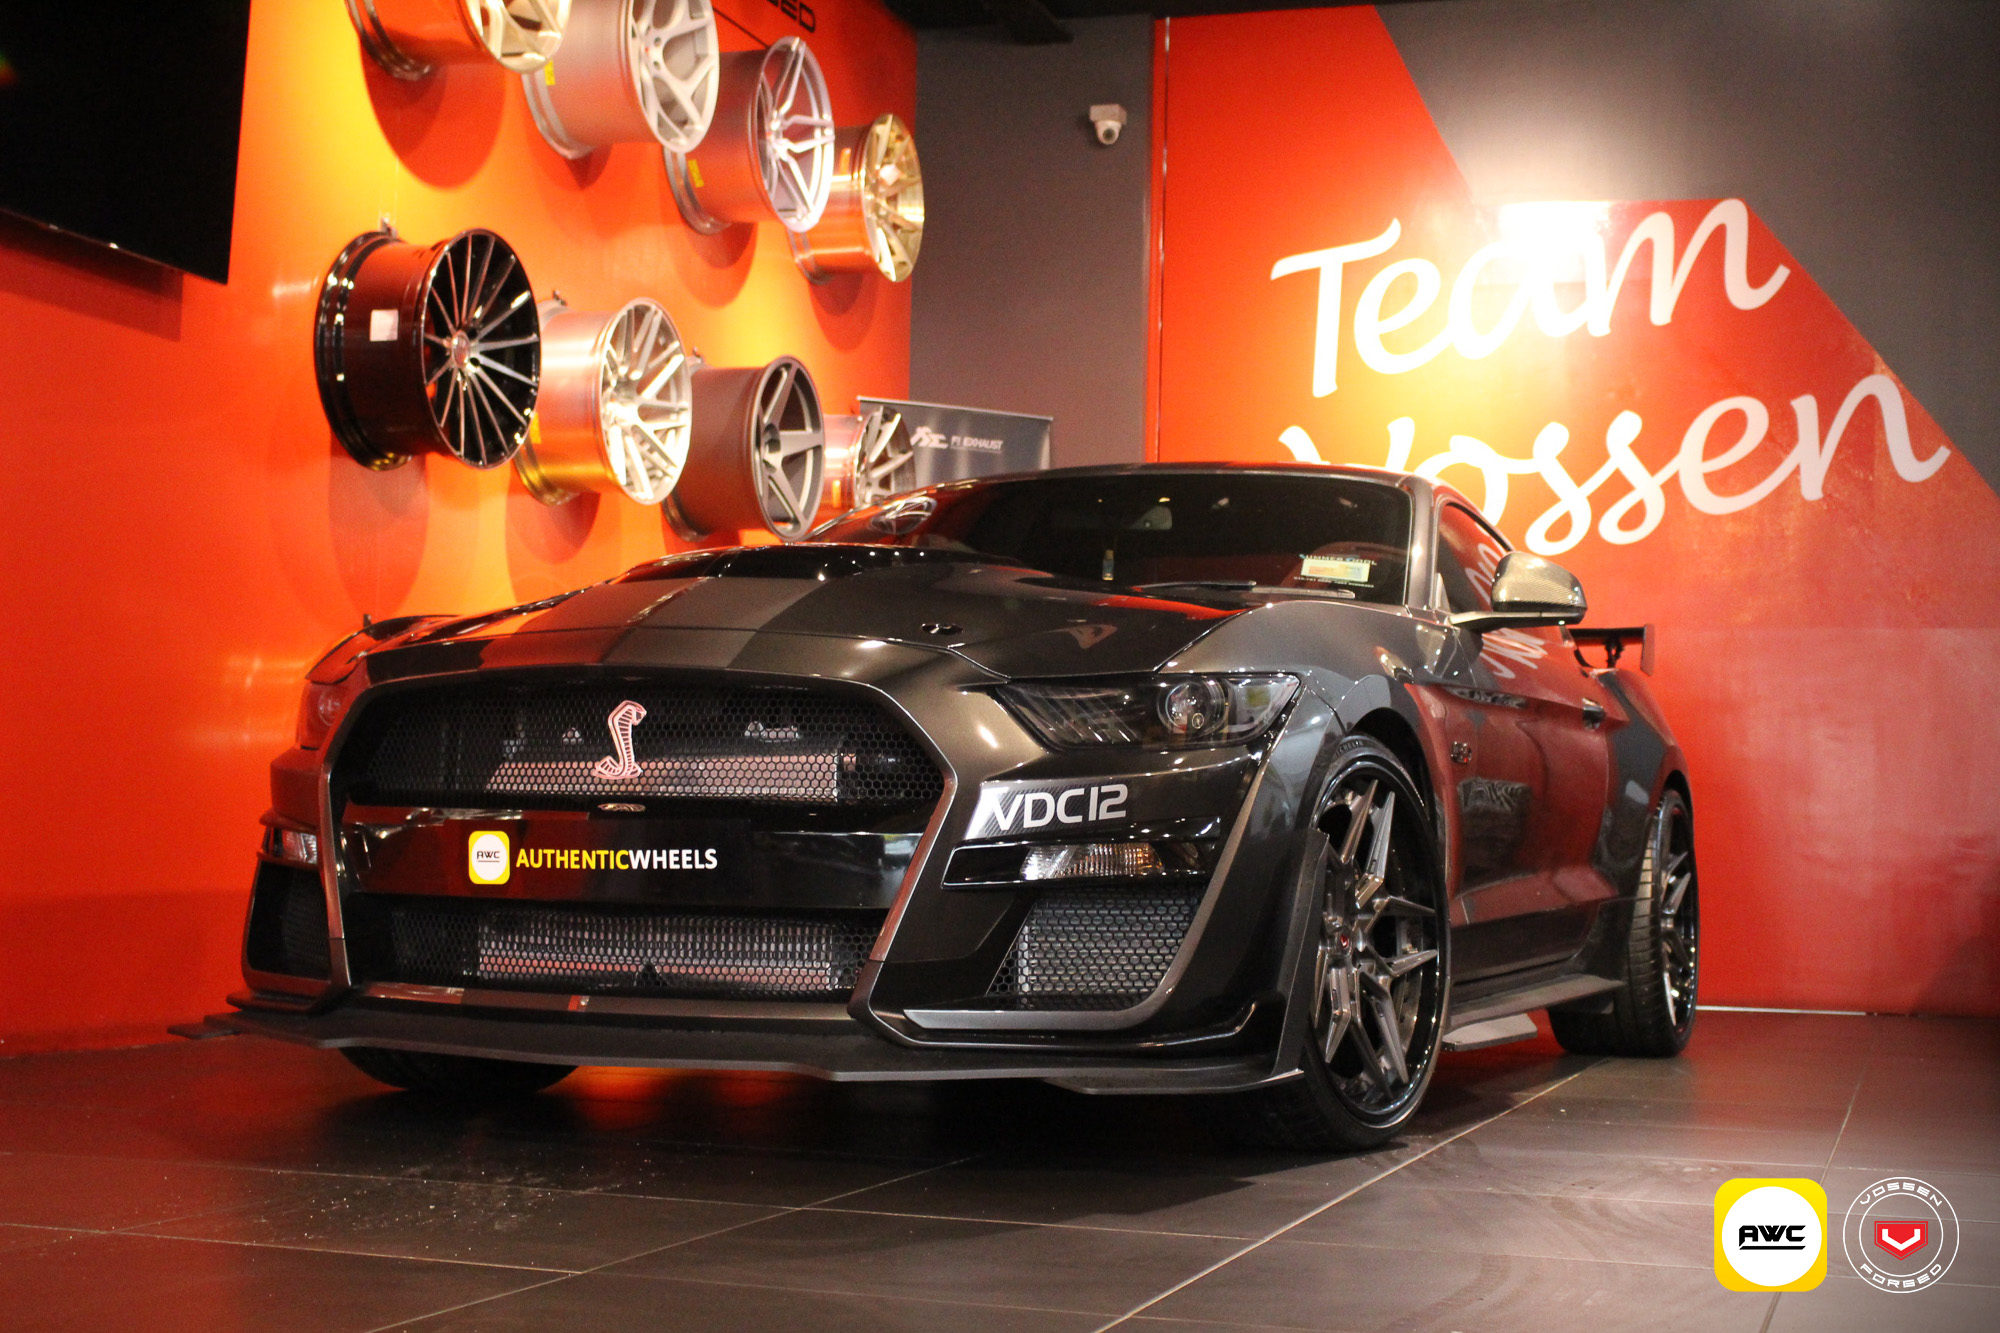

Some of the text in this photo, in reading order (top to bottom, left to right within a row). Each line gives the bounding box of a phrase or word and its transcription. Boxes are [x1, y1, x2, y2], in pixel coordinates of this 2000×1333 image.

[1270, 197, 1790, 398] Team
[963, 436, 1003, 450] EXHAUST
[986, 783, 1128, 831] VDC12
[476, 850, 500, 859] AWC
[516, 848, 718, 869] AUTHENTICWHEELS
